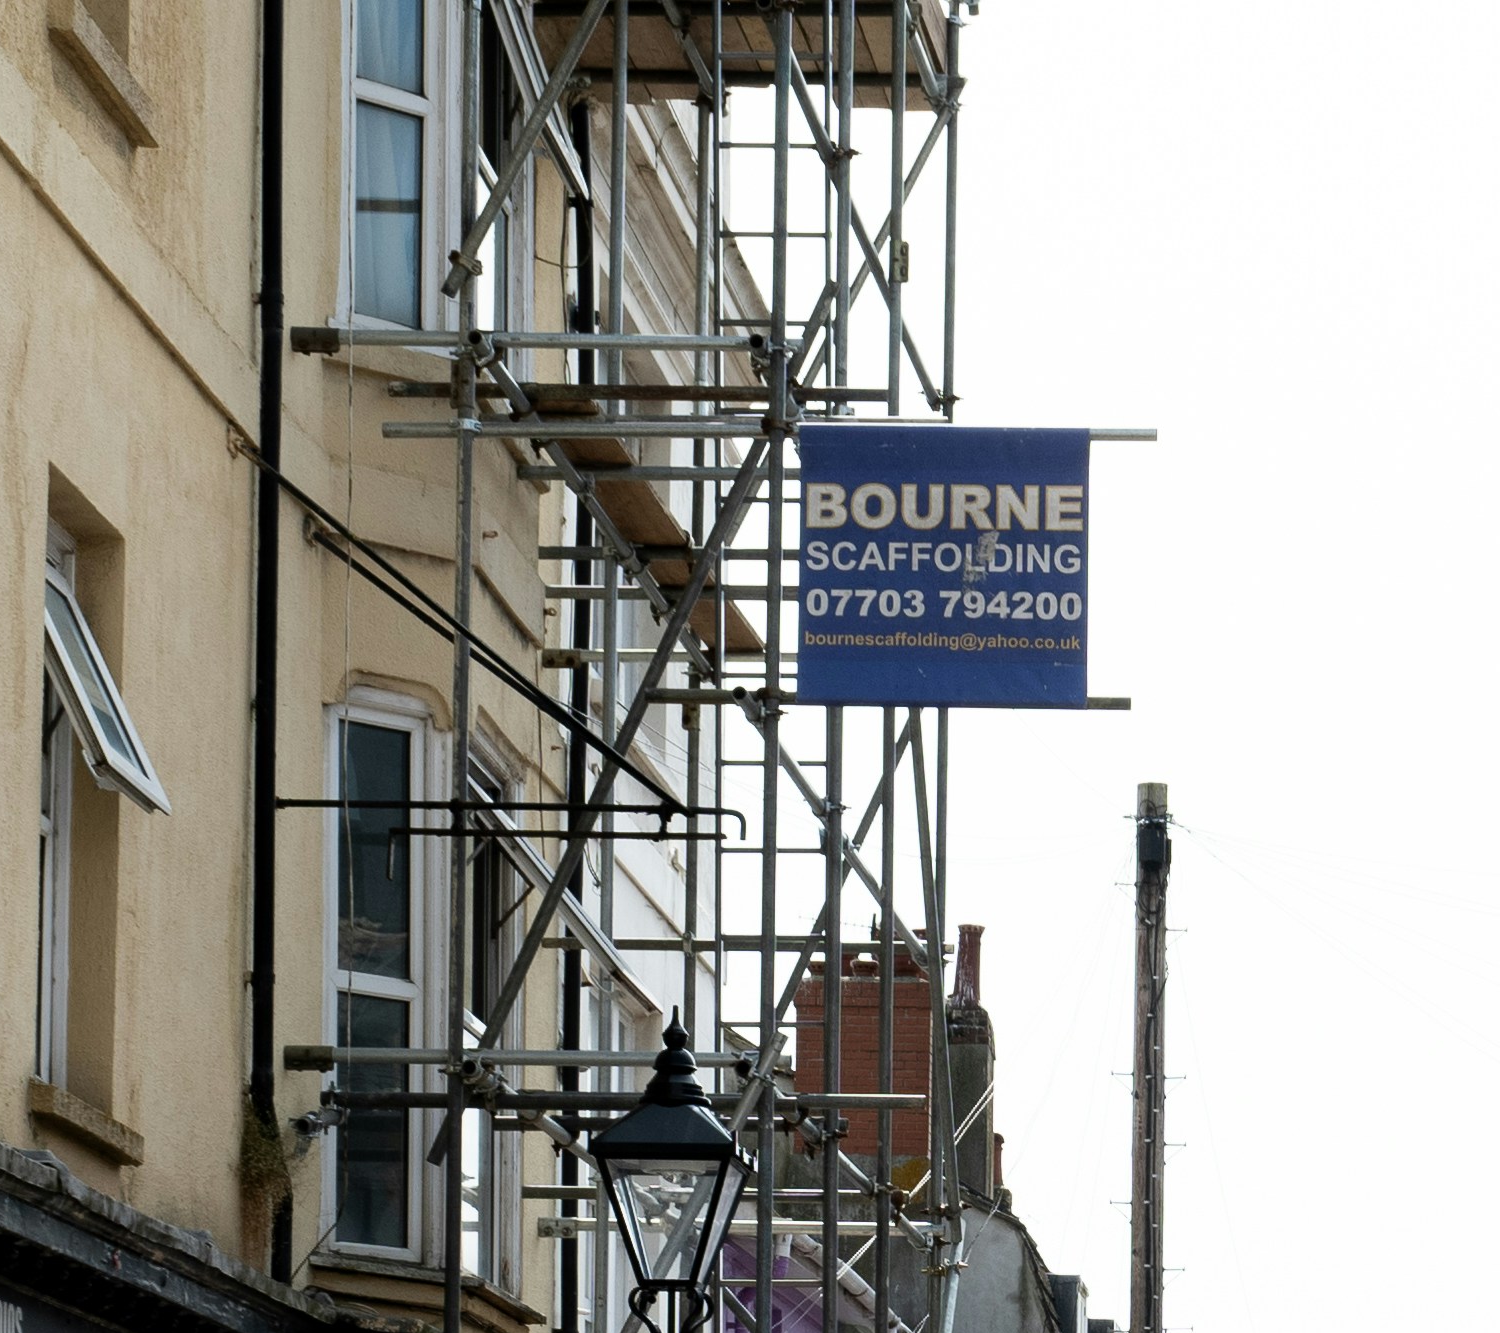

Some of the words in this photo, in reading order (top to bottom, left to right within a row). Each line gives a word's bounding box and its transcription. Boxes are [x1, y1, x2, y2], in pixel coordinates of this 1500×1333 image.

[805, 482, 1084, 531] BOURNE
[805, 541, 1082, 574] SCAFFOLDING
[806, 589, 926, 619] 07703
[939, 590, 1082, 621] 794200
[804, 631, 1081, 652] bournescaffolding@yahoo.co.uk
